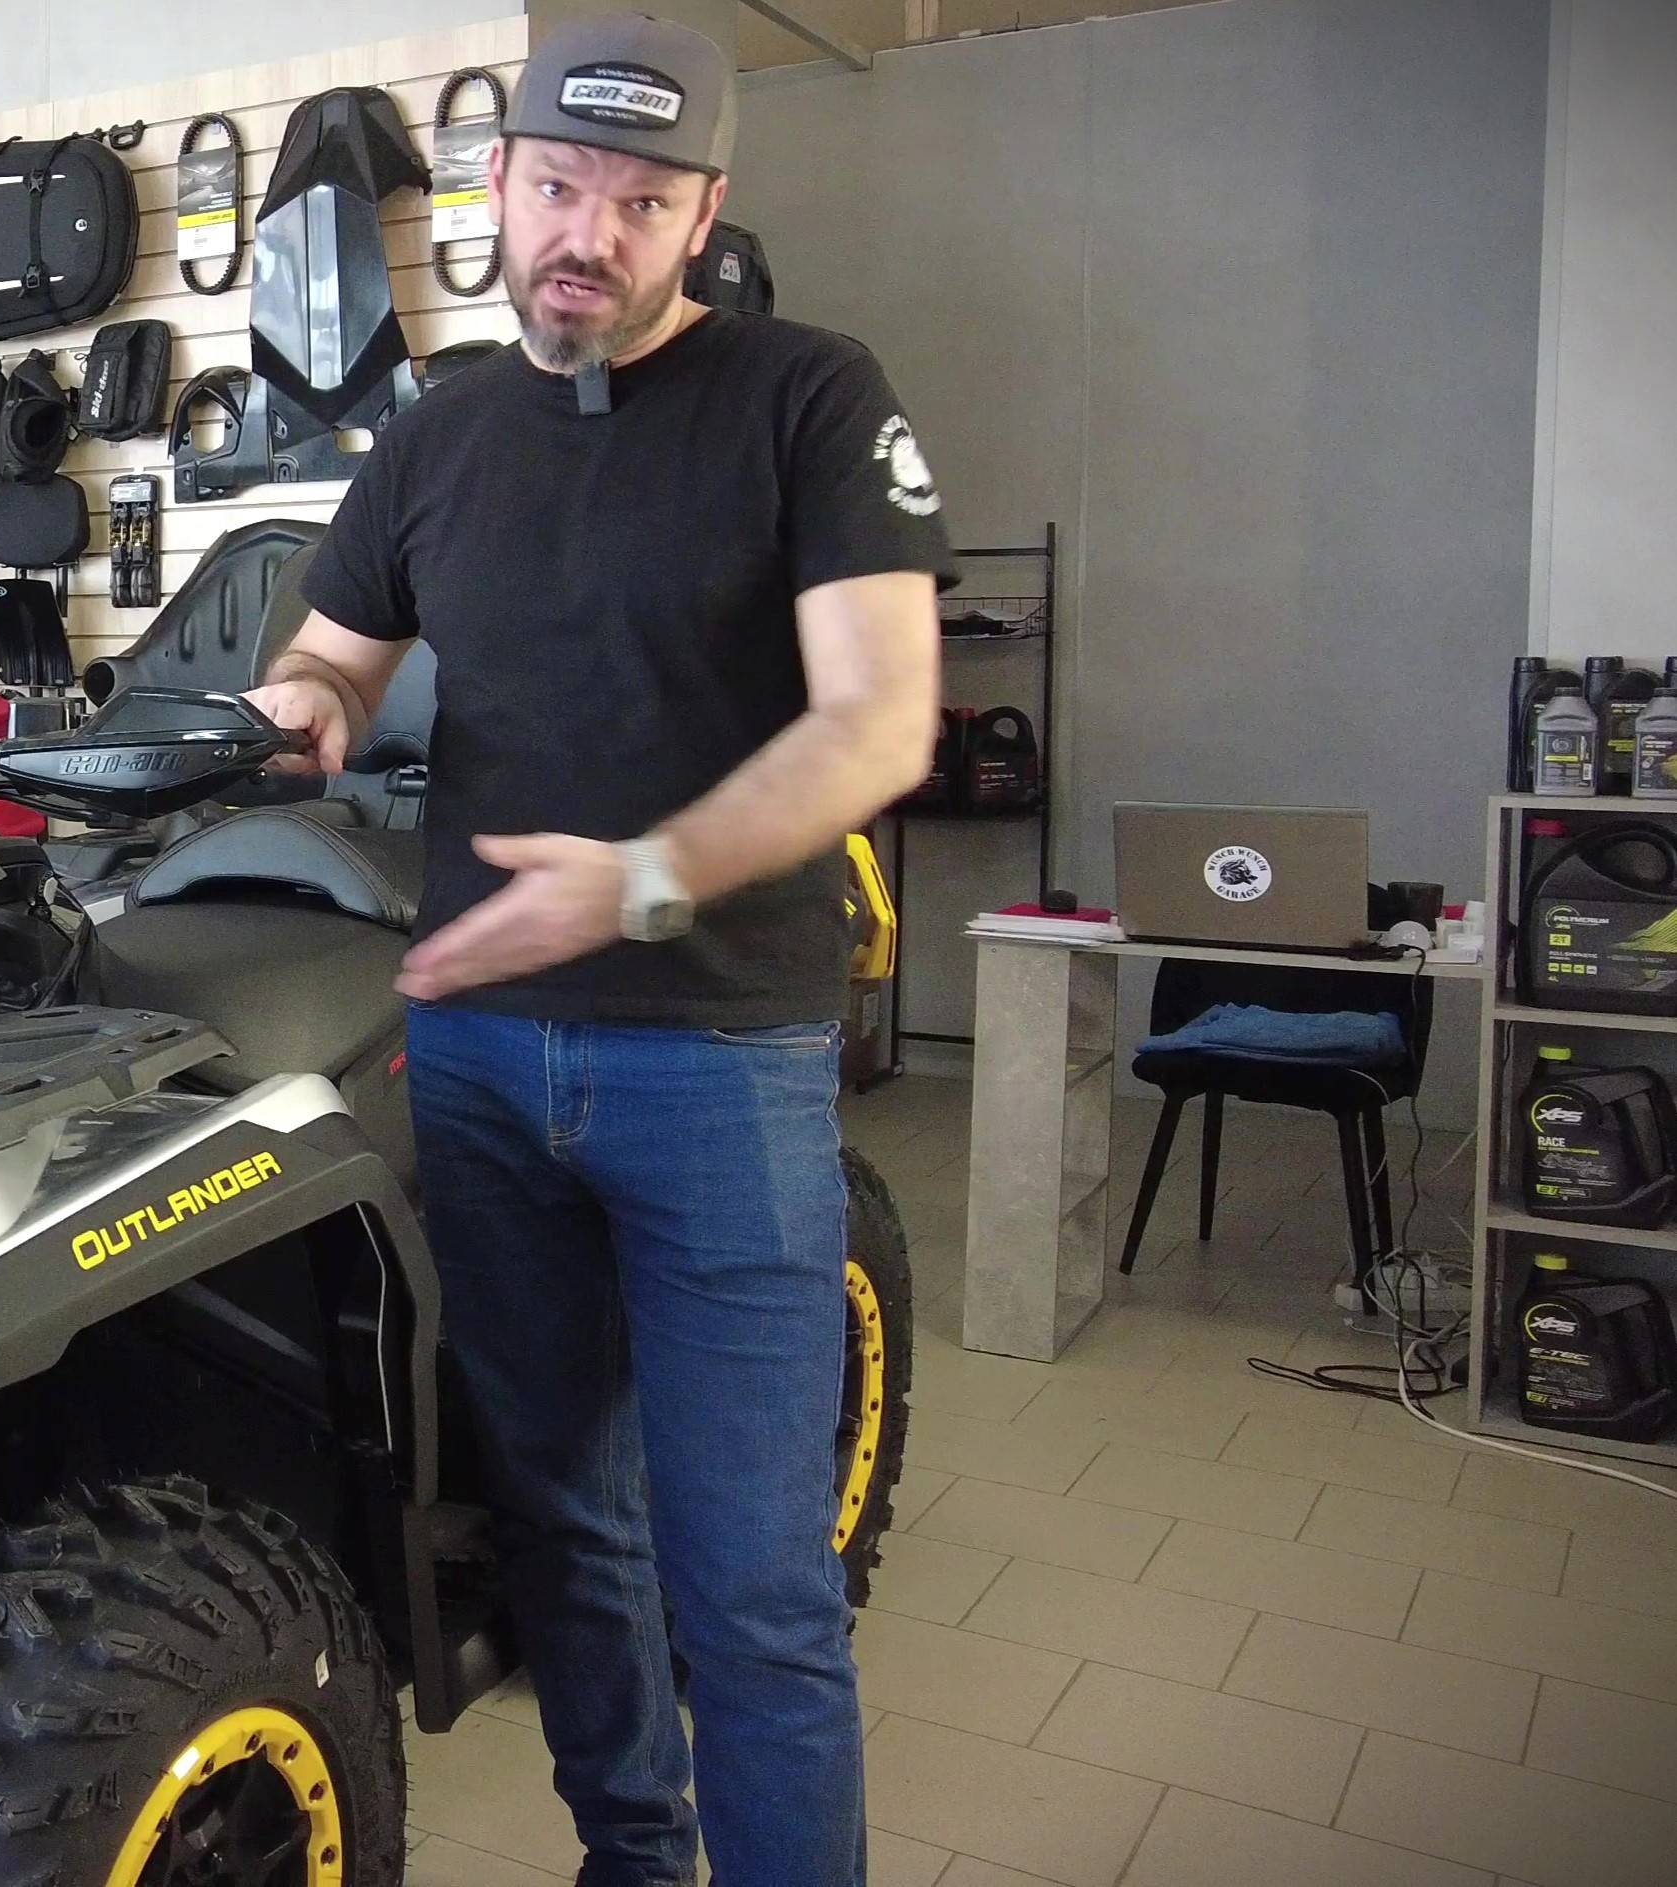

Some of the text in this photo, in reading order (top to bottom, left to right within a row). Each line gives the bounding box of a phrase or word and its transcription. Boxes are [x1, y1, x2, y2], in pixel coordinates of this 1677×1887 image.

[570, 84, 674, 112] can-am
[59, 752, 187, 776] can-am
[1216, 885, 1261, 899] GARAGE
[1536, 1107, 1584, 1122] XPS
[1537, 1136, 1566, 1148] RACE
[72, 1151, 283, 1271] OUTLANDER
[1529, 1316, 1578, 1333] XPS
[1529, 1347, 1593, 1360] E-TEC
